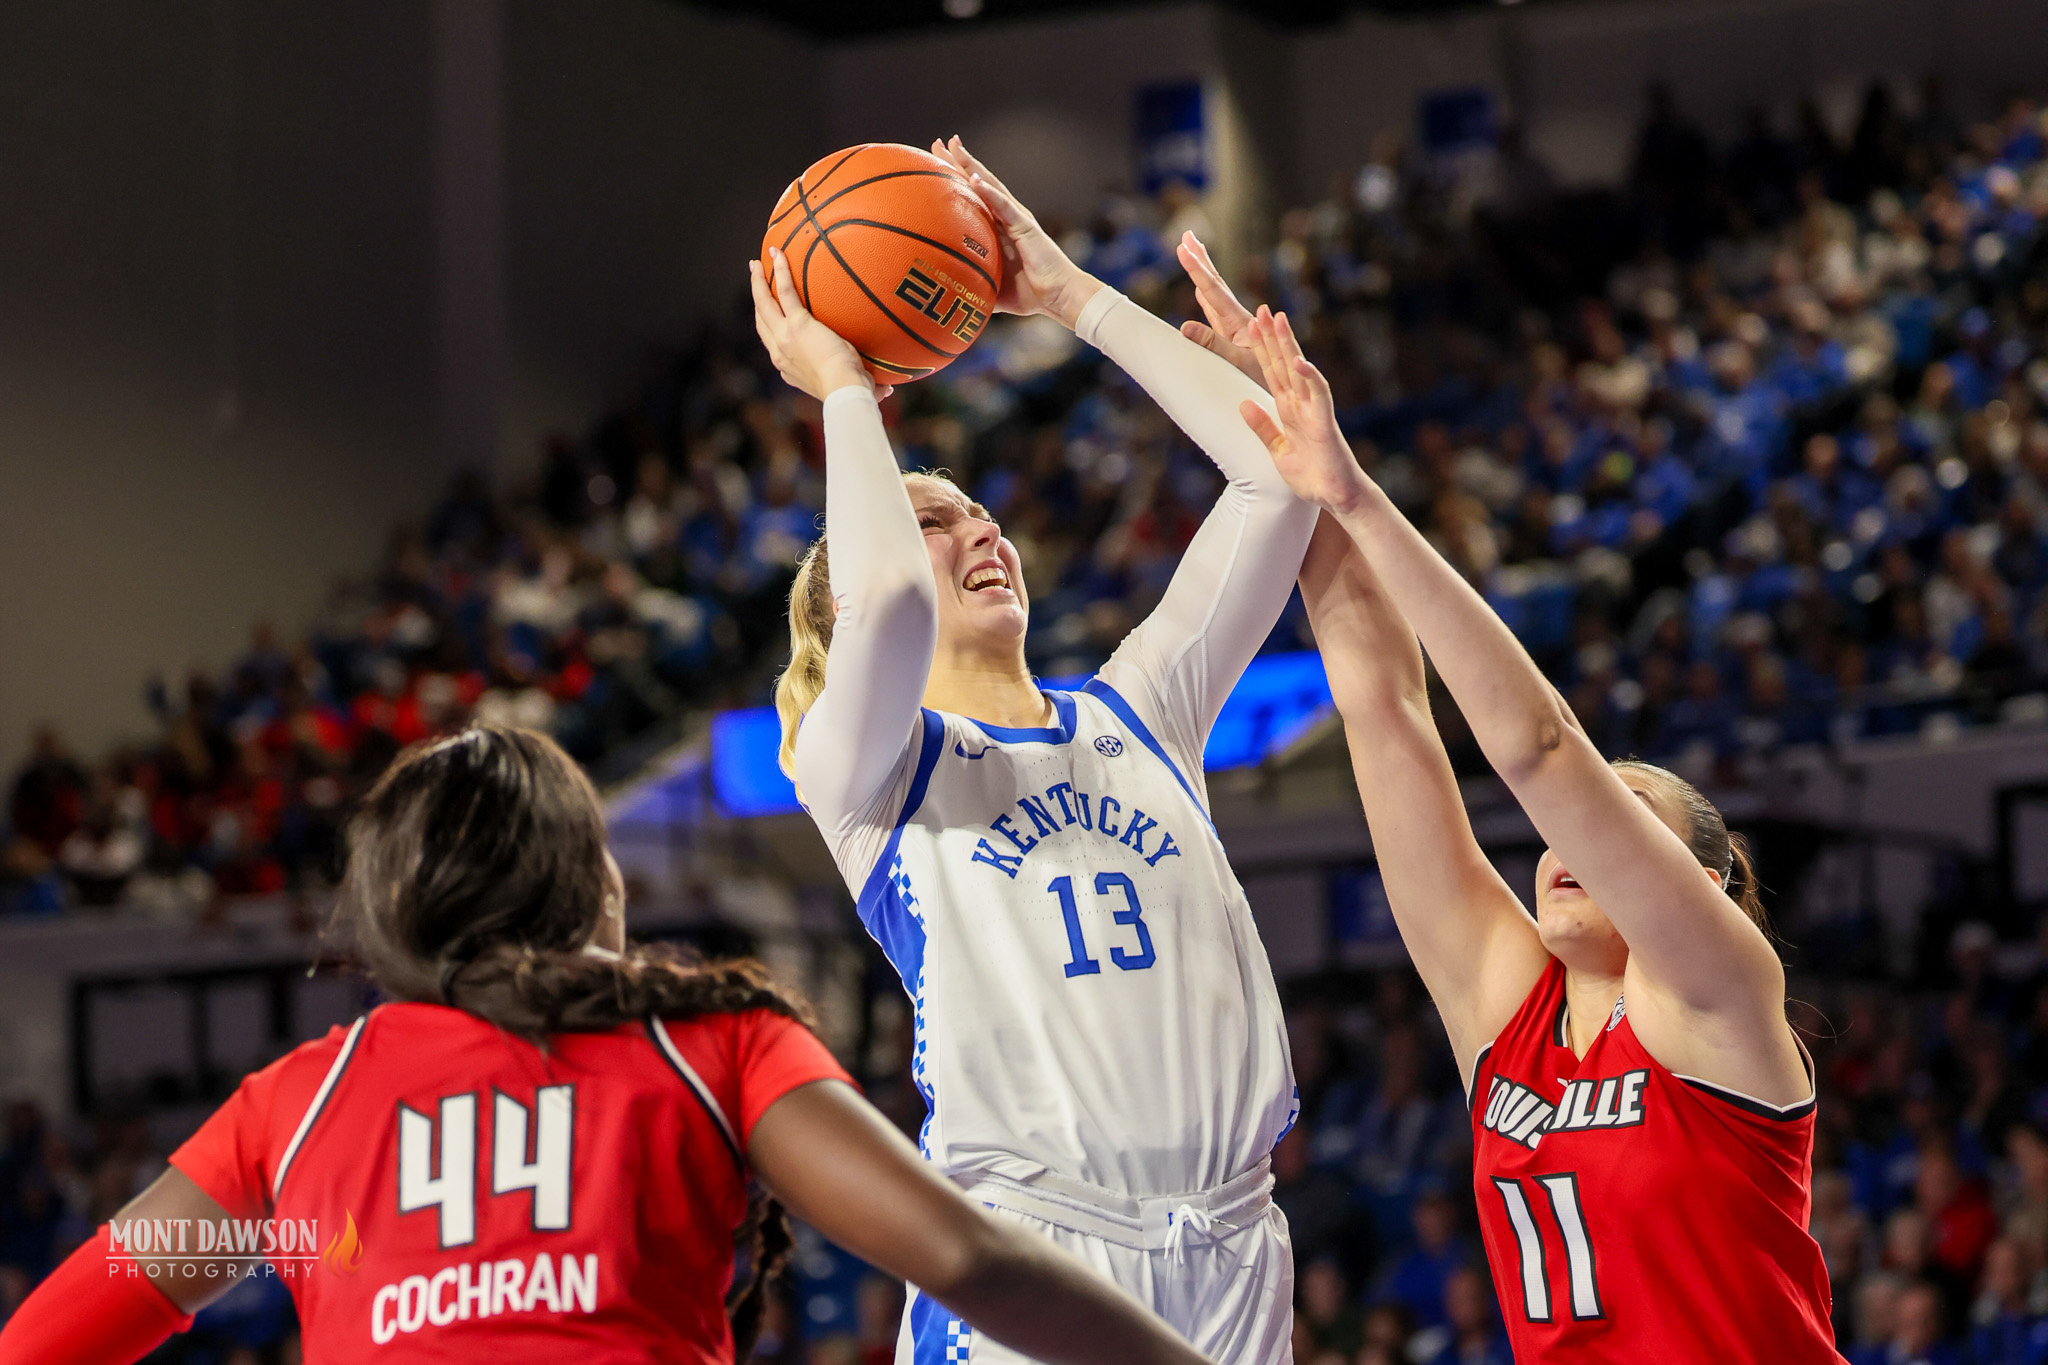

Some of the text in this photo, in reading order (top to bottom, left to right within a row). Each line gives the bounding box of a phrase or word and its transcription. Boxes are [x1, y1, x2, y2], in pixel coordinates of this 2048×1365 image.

[894, 266, 987, 344] ELITE
[914, 257, 986, 307] AMPIONSHIP
[1095, 736, 1122, 757] SEC
[971, 782, 1181, 879] KENTUCKY
[1047, 872, 1156, 978] 13
[1481, 1068, 1650, 1151] OUIILLE
[397, 1083, 576, 1251] 44
[1490, 1172, 1606, 1323] 11
[371, 1252, 598, 1344] COCHRAN
